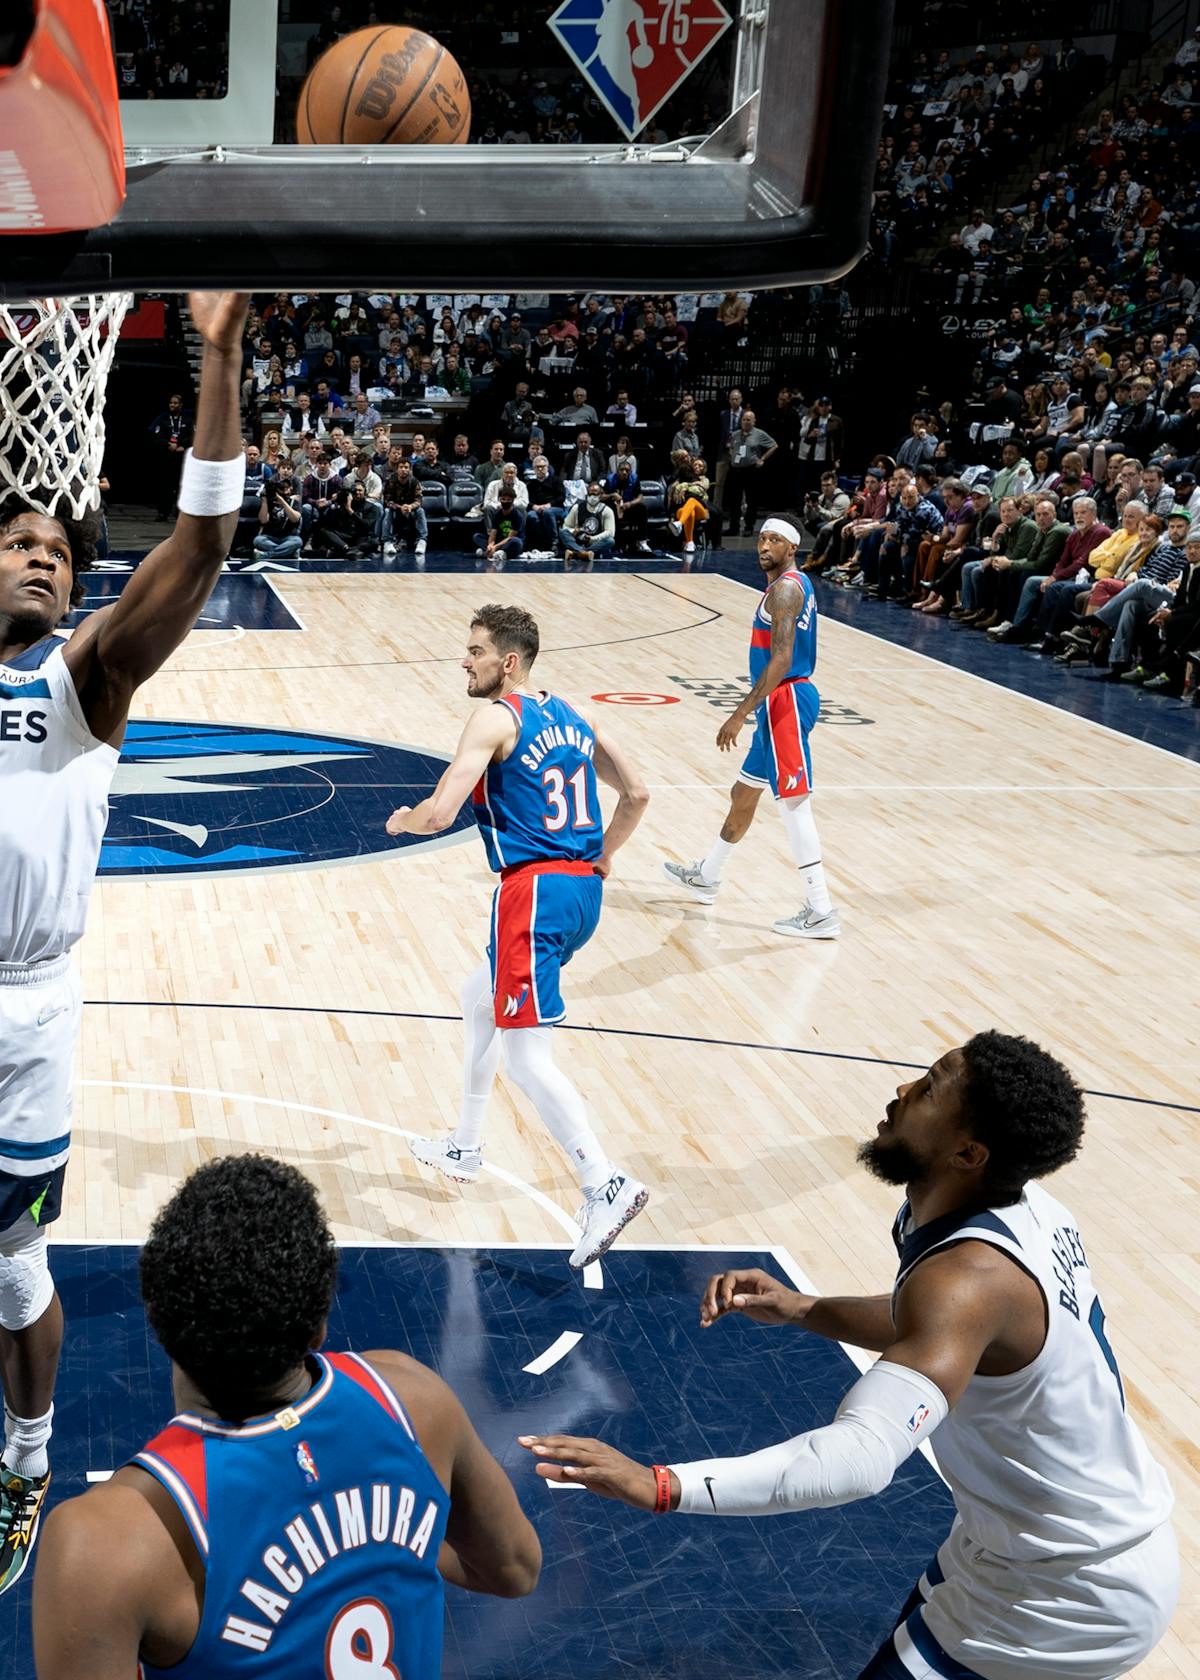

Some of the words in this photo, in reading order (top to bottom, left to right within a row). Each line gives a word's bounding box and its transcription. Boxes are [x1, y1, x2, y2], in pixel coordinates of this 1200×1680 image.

[658, 0, 689, 45] 75
[962, 319, 1007, 330] LEX
[542, 762, 595, 832] 31
[221, 1484, 439, 1653] HACHIMURA
